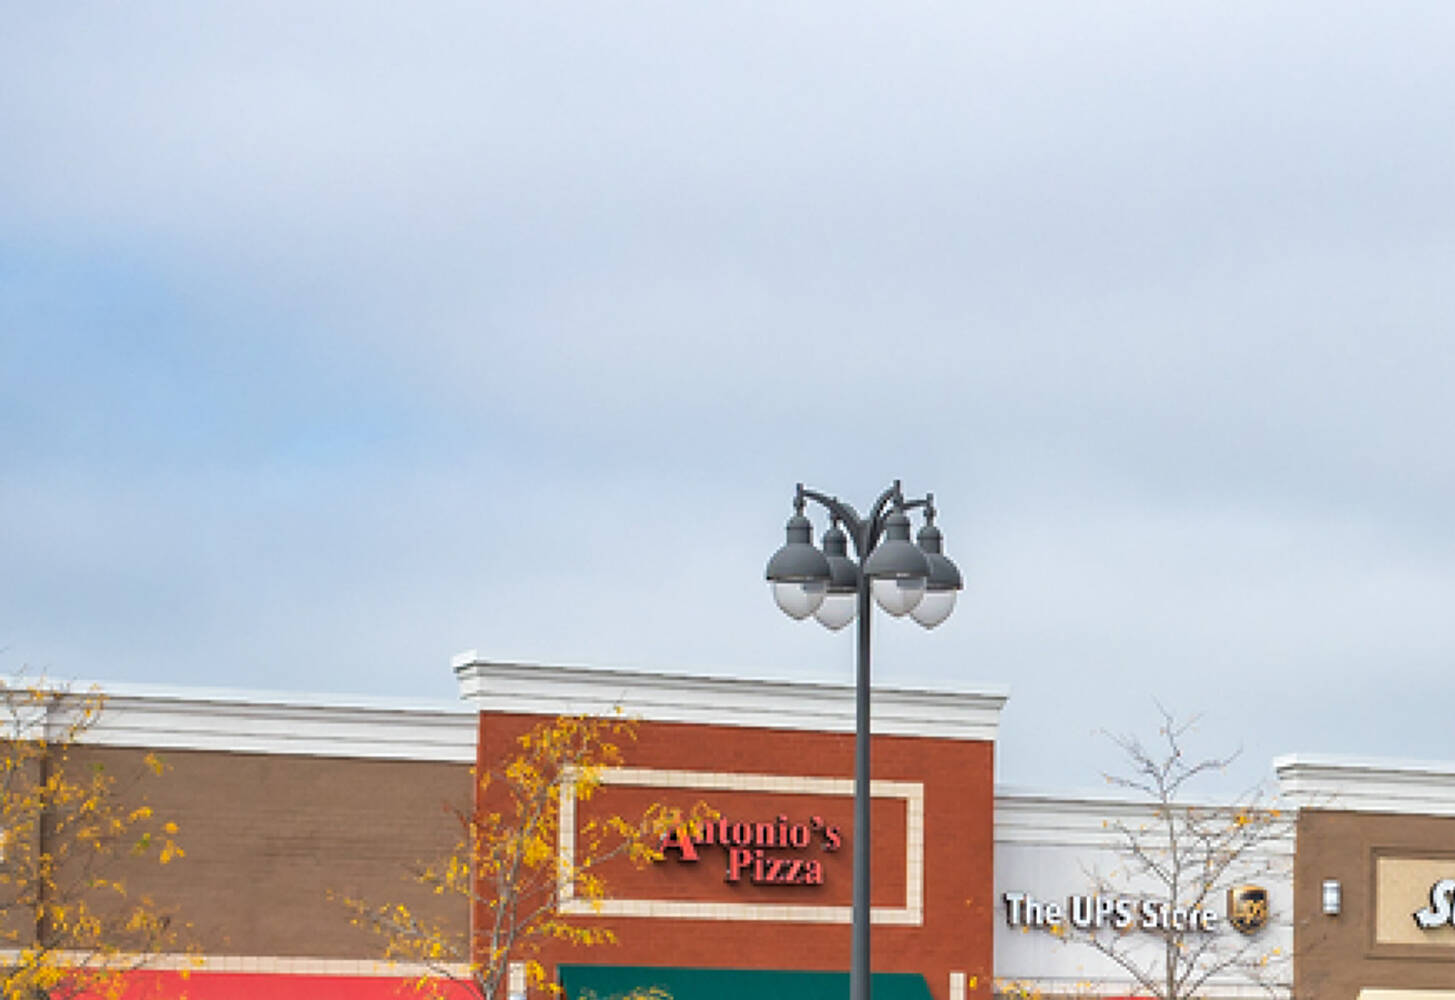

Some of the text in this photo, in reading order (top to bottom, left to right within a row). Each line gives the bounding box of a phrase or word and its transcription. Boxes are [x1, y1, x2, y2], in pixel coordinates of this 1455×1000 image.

[659, 812, 841, 861] Antonio's
[728, 848, 824, 884] Pizza
[1004, 892, 1219, 931] The UPS Store
